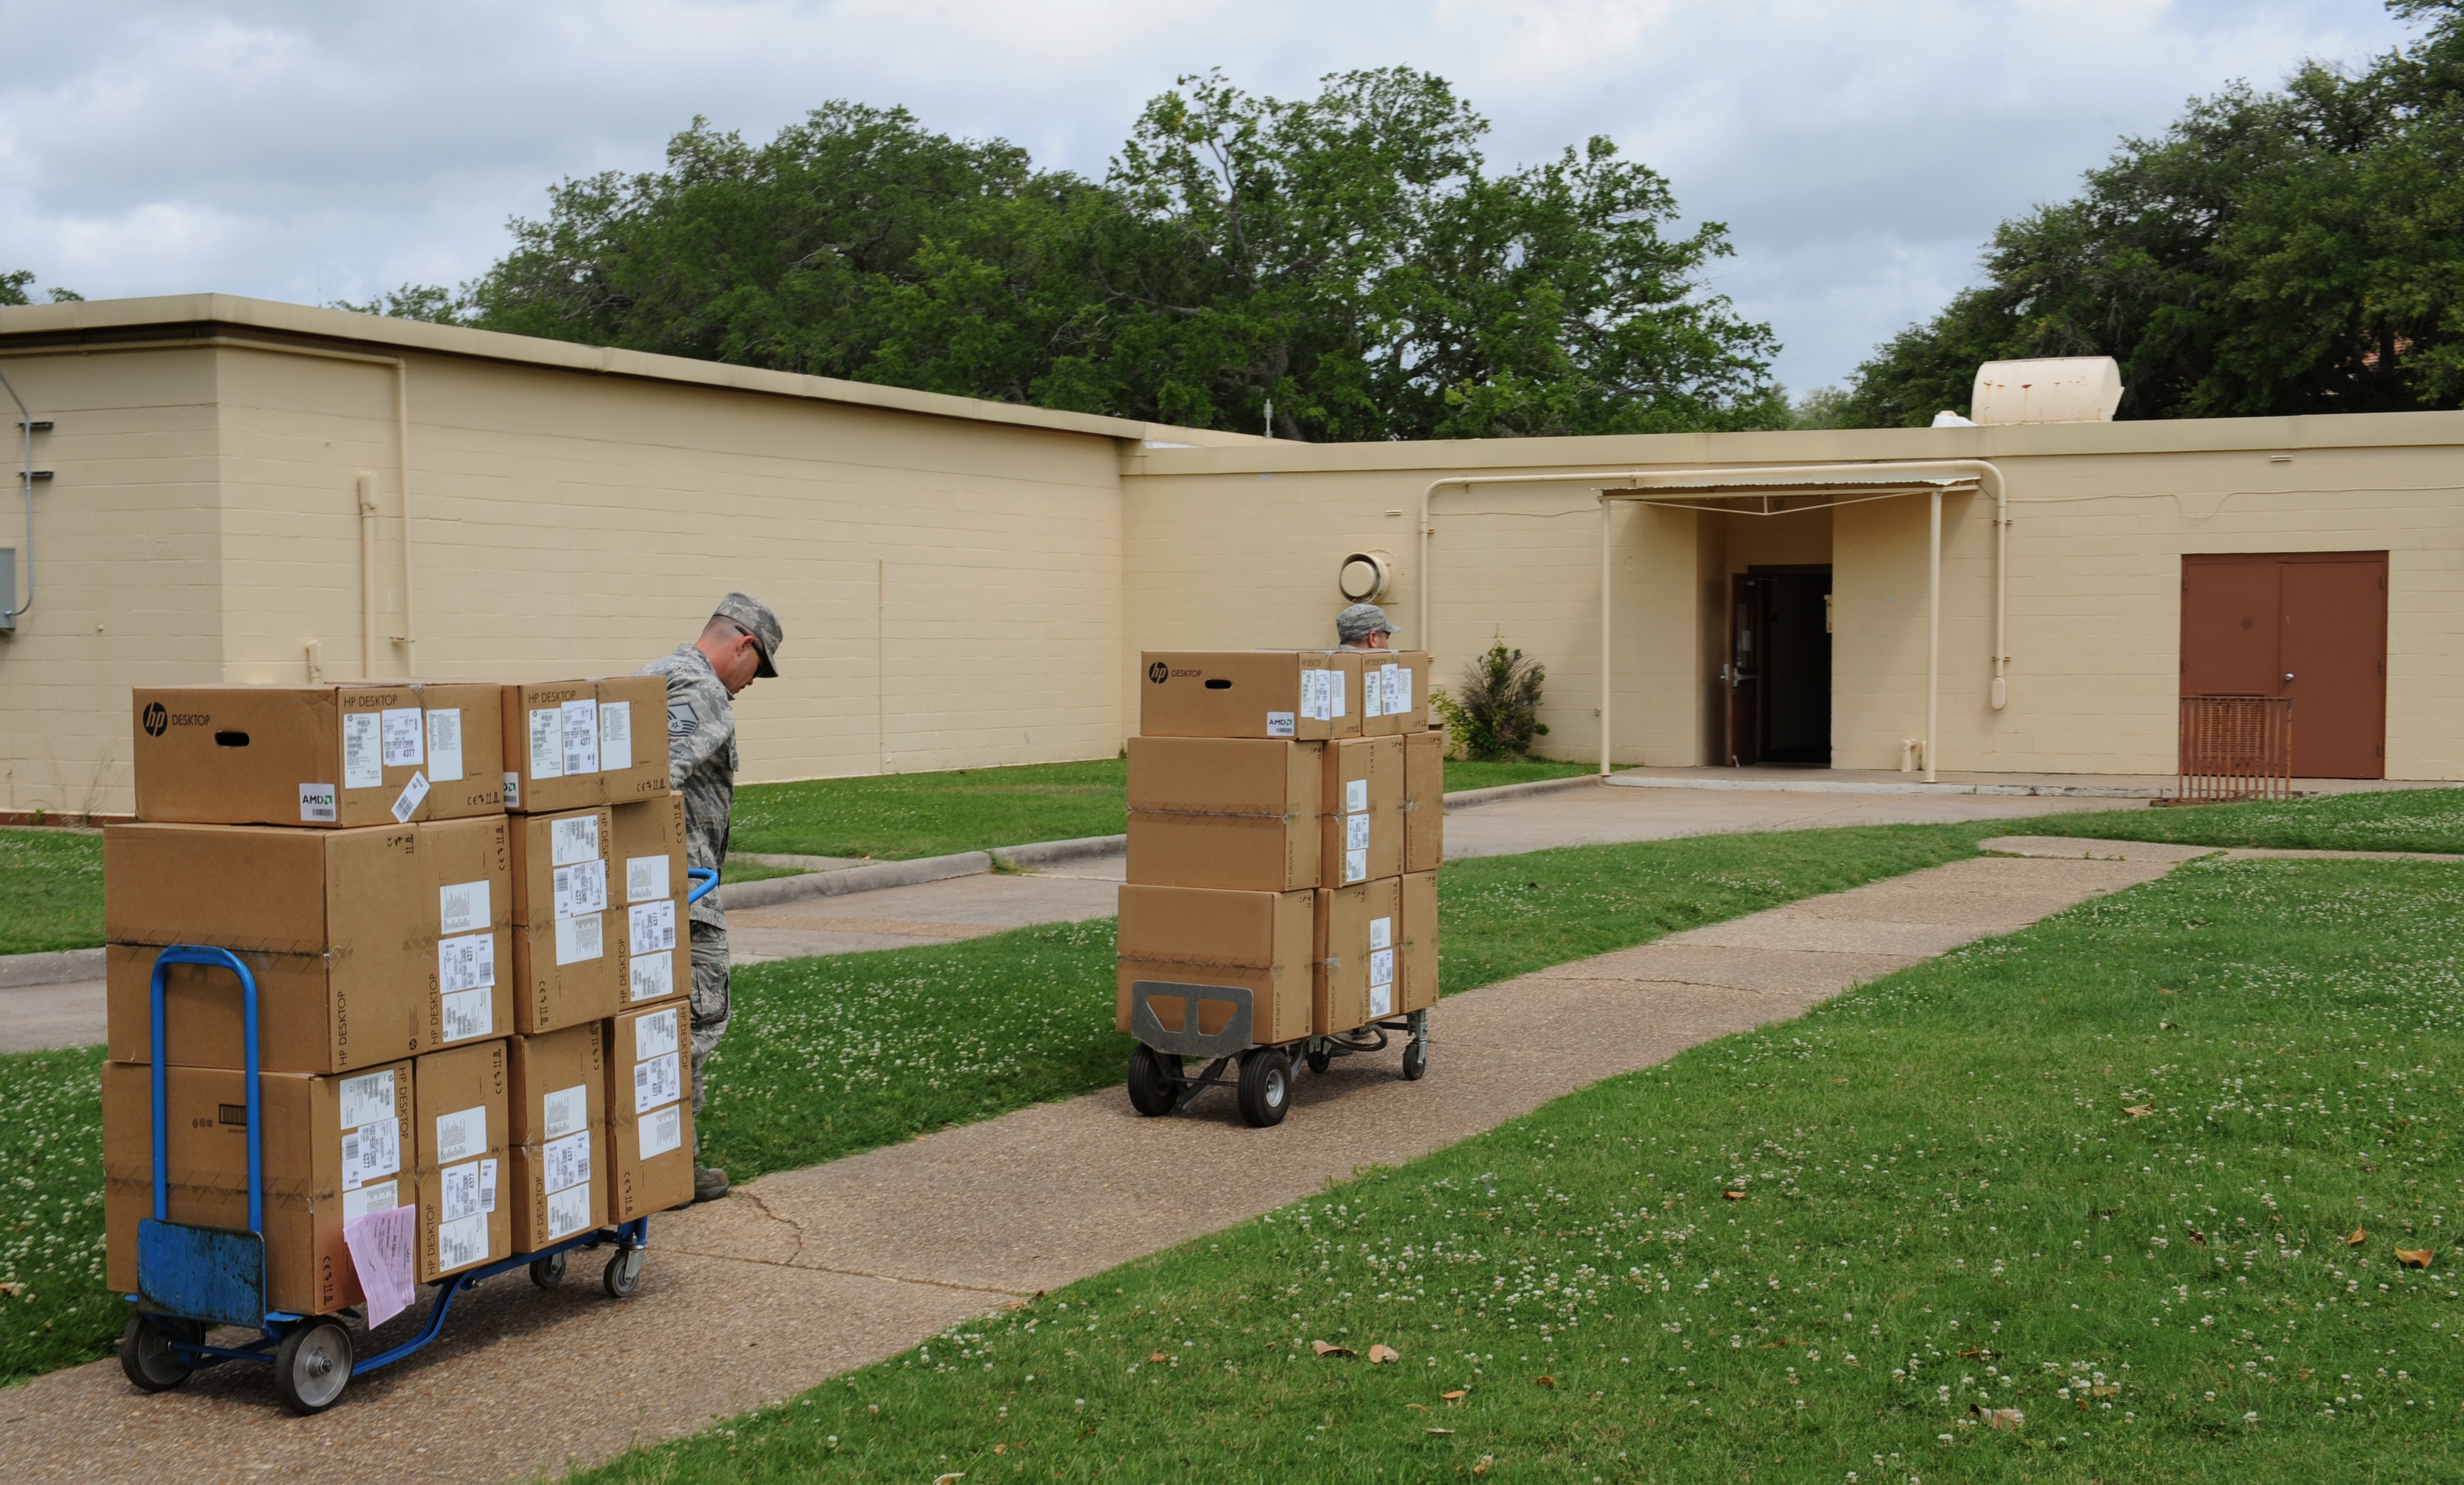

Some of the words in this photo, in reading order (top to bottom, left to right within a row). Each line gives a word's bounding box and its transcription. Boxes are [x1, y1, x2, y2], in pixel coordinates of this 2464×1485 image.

[1149, 662, 1168, 684] hp
[345, 697, 356, 707] HP
[359, 695, 397, 707] DESKTOP
[529, 693, 539, 703] HP
[542, 690, 576, 702] DESKTOP
[144, 702, 167, 737] hp
[172, 715, 210, 726] DESKTOP
[580, 738, 591, 746] 4377
[403, 749, 415, 757] 4377
[303, 795, 323, 804] AMD
[601, 813, 607, 826] HP
[618, 939, 627, 987] DESKTOP
[429, 974, 438, 1025] DESKTOP
[620, 990, 627, 1003] HP
[338, 991, 346, 1046] DESKTOP
[680, 1007, 686, 1020] HP
[431, 1030, 438, 1045] HP
[339, 1050, 346, 1065] HP
[399, 1067, 407, 1082] HP
[400, 1086, 408, 1139] DESKTOP
[427, 1204, 436, 1256] DESKTOP
[537, 1230, 544, 1244] HP
[428, 1261, 435, 1276] HP
